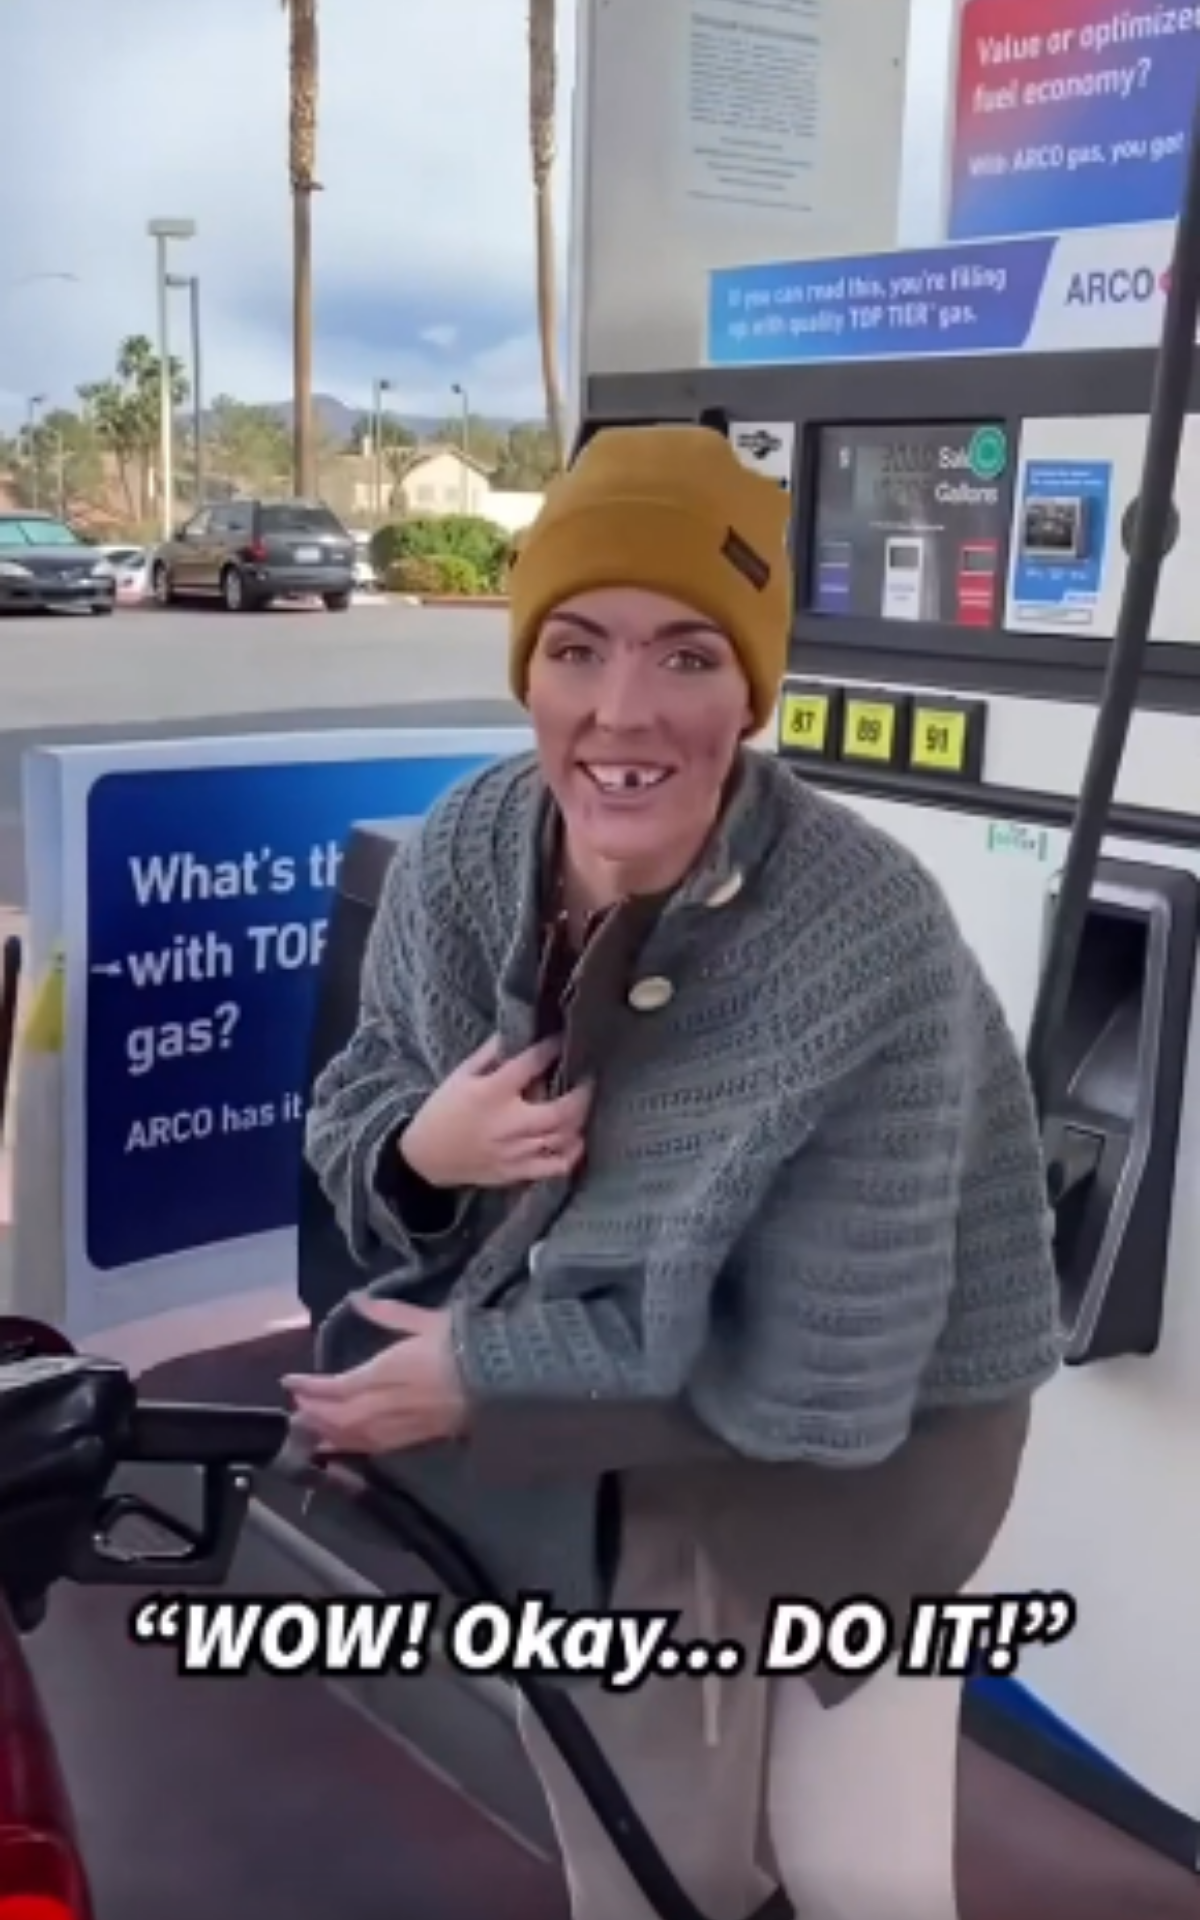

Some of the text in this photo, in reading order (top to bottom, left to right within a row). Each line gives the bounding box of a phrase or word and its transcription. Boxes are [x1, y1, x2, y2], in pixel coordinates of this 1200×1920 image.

[977, 33, 1041, 66] Value
[1046, 28, 1075, 54] or
[973, 57, 1152, 112] fuel economy?
[1012, 145, 1064, 171] ARCO
[1064, 266, 1155, 307] ARCO
[848, 304, 882, 330] TOP
[128, 848, 295, 906] What's
[128, 931, 233, 988] with
[127, 1001, 240, 1076] gas?
[124, 1093, 303, 1153] ARCO has it
